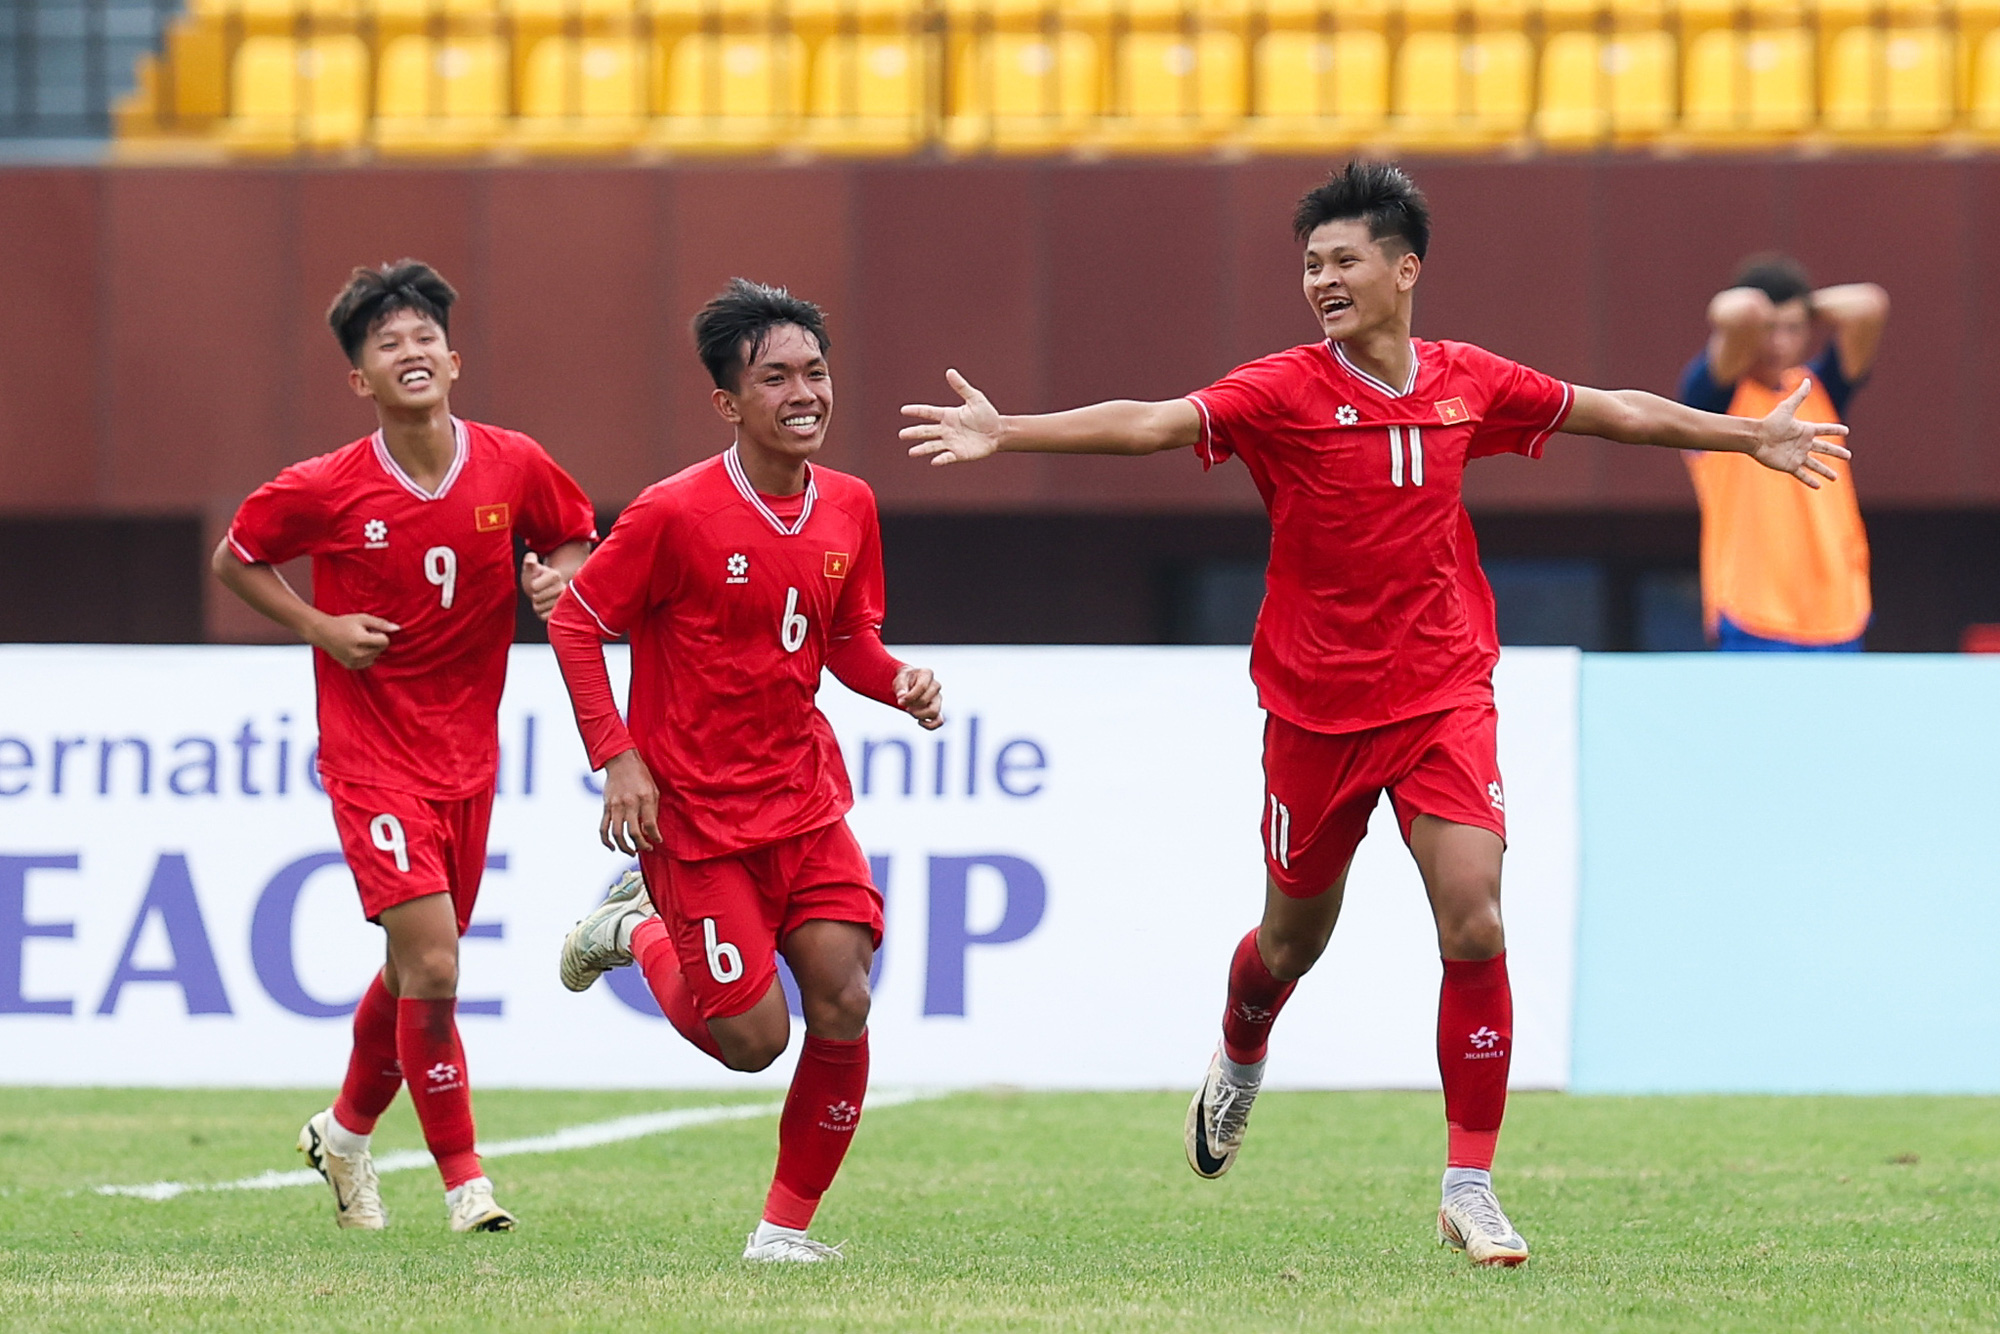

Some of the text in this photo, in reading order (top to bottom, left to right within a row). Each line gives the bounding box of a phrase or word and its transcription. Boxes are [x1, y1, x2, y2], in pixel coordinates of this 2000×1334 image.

[1387, 425, 1424, 487] 11
[423, 545, 457, 610] 9
[781, 586, 809, 653] 6
[0, 715, 535, 796] ernatil
[369, 813, 410, 872] 9
[1270, 792, 1290, 870] 11
[703, 917, 743, 984] 6
